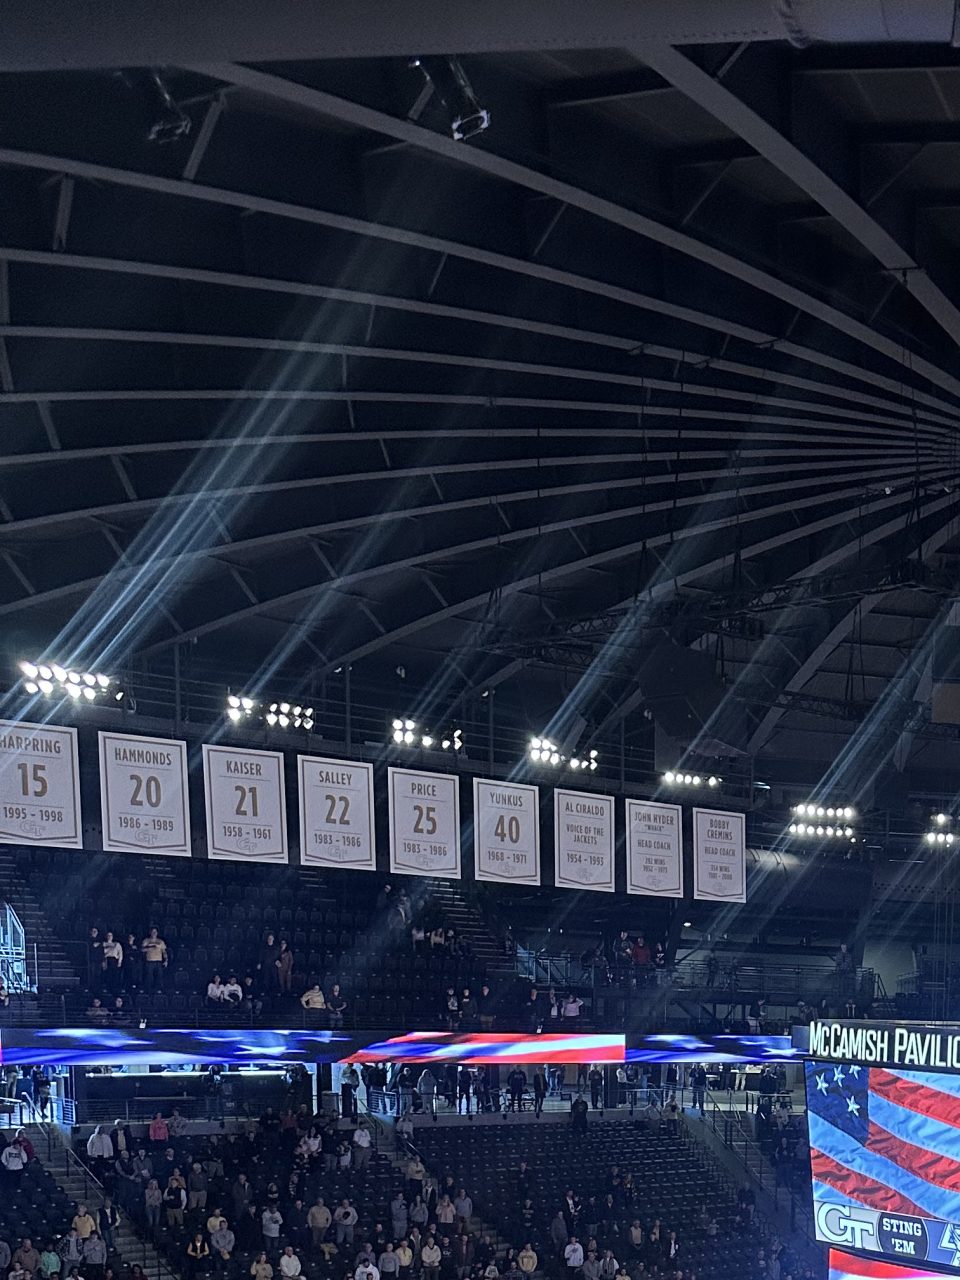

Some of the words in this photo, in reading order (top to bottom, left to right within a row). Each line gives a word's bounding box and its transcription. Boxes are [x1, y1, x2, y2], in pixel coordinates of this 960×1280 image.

[114, 747, 172, 766] HAMMONDS
[226, 760, 262, 776] KAISER
[18, 763, 48, 797] 15
[319, 770, 352, 786] SALLEY
[130, 774, 162, 807] 20
[411, 782, 437, 797] PRICE
[234, 785, 260, 817] 21
[490, 792, 523, 807] YUNKUS
[3, 807, 27, 819] 1995
[40, 810, 63, 822] 1998
[325, 794, 351, 825] 22
[565, 802, 574, 813] AL
[576, 803, 605, 816] CIRALDO
[118, 816, 141, 829] 1986
[152, 819, 174, 832] 1989
[413, 805, 437, 835] 25
[634, 812, 651, 823] JOHN
[653, 814, 674, 825] HYDER
[709, 819, 729, 830] BOBBY
[223, 825, 243, 838] 1958
[253, 828, 271, 840] 1961
[494, 815, 520, 844] 40
[566, 824, 582, 833] VOICE
[584, 825, 592, 834] OF
[593, 827, 604, 836] THE
[707, 829, 732, 841] CREMINS
[314, 833, 333, 845] 1983
[343, 835, 361, 847] 1986
[574, 834, 597, 845] JACKETS
[638, 840, 652, 849] HEAD
[653, 841, 671, 850] COACH
[403, 842, 421, 854] 1983
[430, 845, 447, 856] 1986
[719, 848, 736, 857] COACH
[488, 851, 504, 861] 1968
[513, 854, 527, 864] 1971
[567, 853, 581, 864] 1954
[589, 856, 604, 866] 1993
[809, 1021, 888, 1063] McCAMISH
[882, 1218, 922, 1237] STING
[891, 1239, 915, 1255] 'EM
